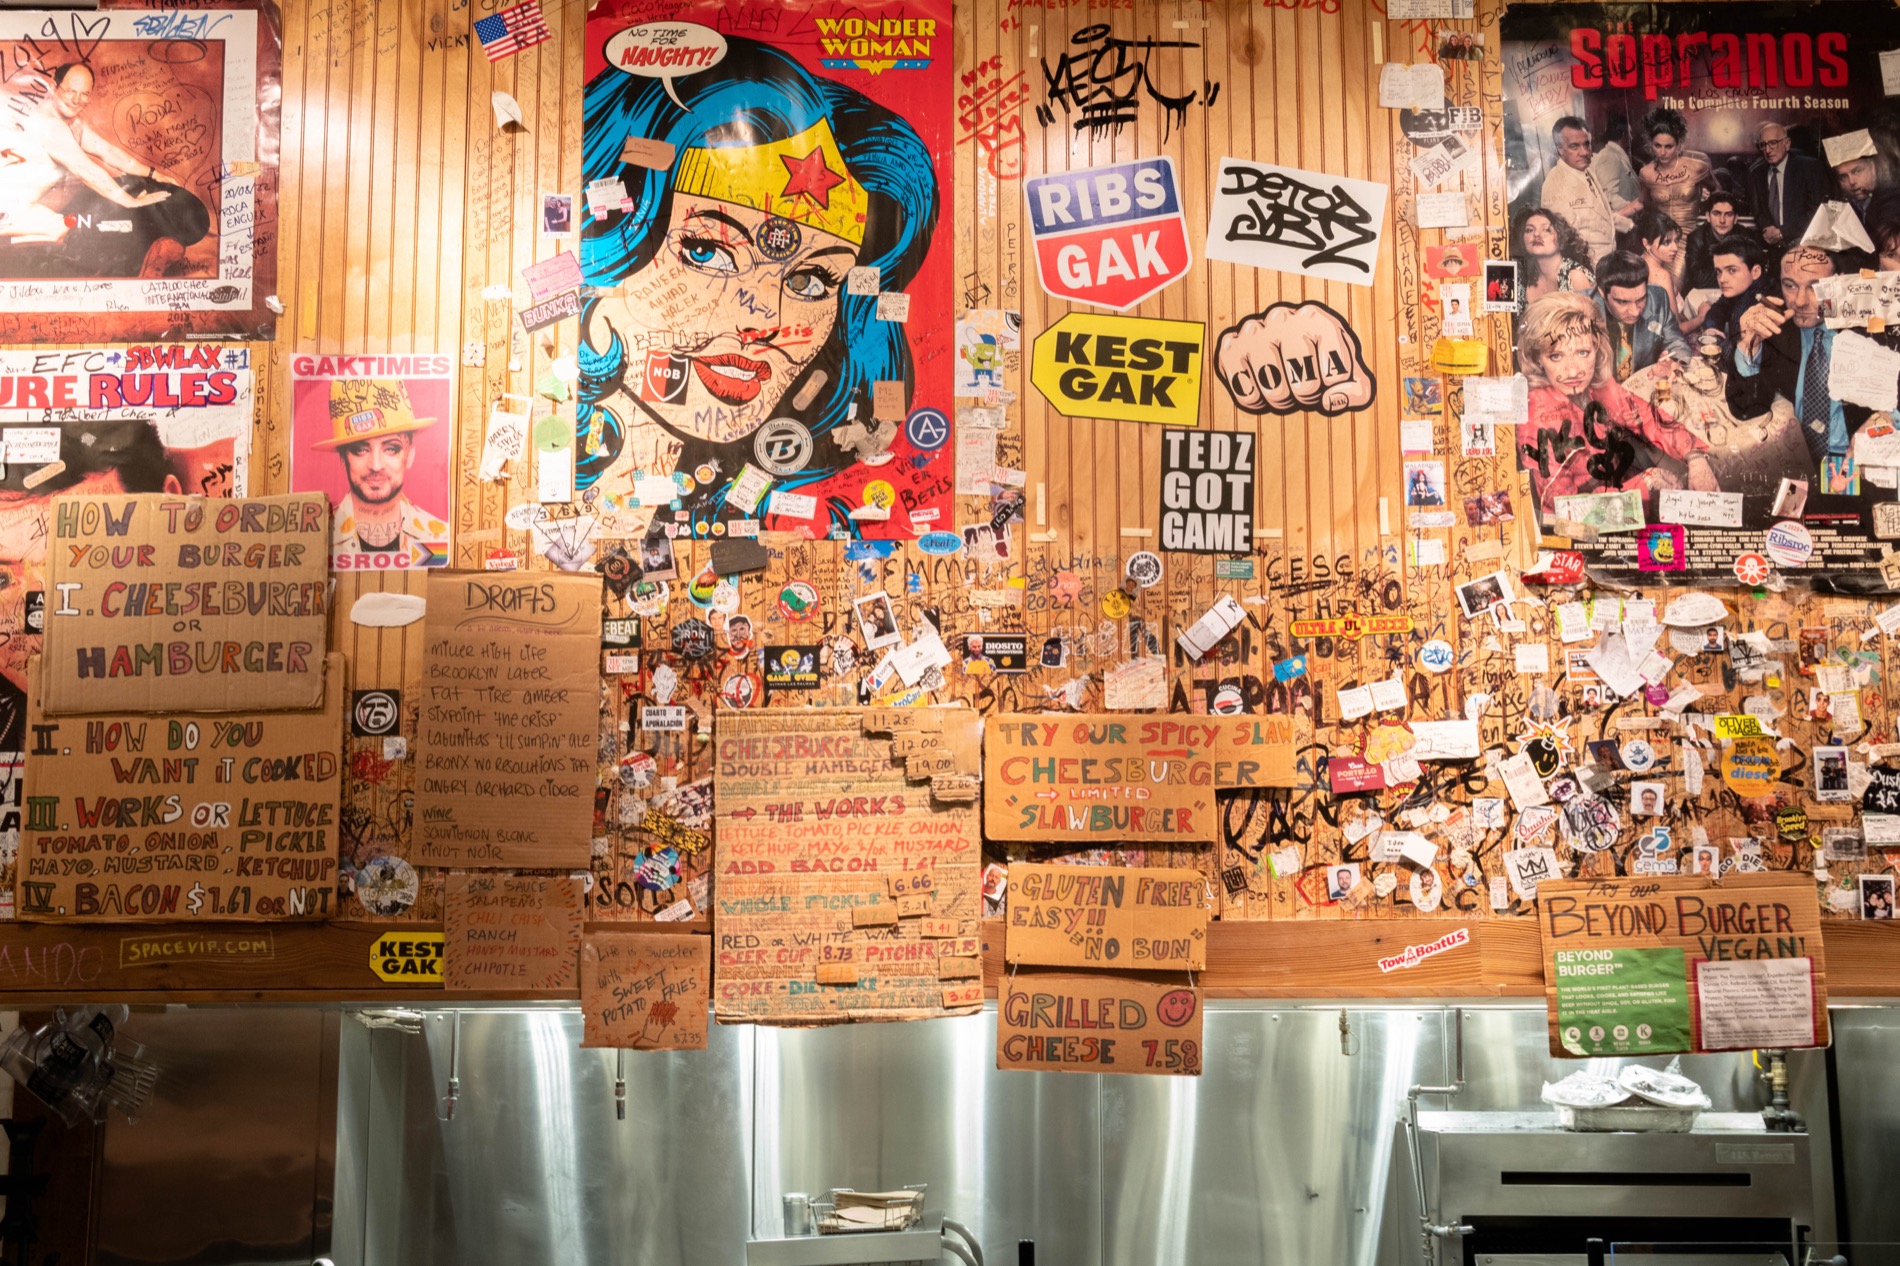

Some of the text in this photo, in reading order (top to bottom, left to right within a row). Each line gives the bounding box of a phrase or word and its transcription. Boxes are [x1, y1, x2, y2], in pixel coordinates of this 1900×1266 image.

[628, 28, 688, 37] NO TIME
[816, 18, 936, 38] WONDER
[650, 38, 678, 46] FOR
[820, 39, 930, 57] WOMAN
[620, 46, 717, 67] NAUGHTY!
[1569, 27, 1849, 100] Sopranos
[1663, 97, 1849, 112] The Complete Fourth Season
[1037, 168, 1167, 227] RIBS
[1057, 230, 1169, 290] GAK
[125, 345, 223, 371] SBWLAX
[1054, 332, 1199, 374] KEST
[293, 356, 450, 376] GAKTIMES
[653, 365, 681, 380] NOB
[1231, 350, 1348, 397] COMA
[89, 373, 237, 409] RULES
[1059, 367, 1177, 408] GAK
[1166, 431, 1252, 471] TEDZ
[1163, 471, 1251, 511] GOT
[56, 501, 323, 538] HOW TO ORDER
[1162, 511, 1250, 550] GAME
[1768, 532, 1811, 552] Ribsroc
[68, 543, 306, 569] YOUR BURGER
[1554, 553, 1580, 572] STAR
[102, 581, 328, 618] CHEESEBURGER
[172, 619, 202, 632] OR
[1295, 618, 1409, 635] ULTRA LECCE
[985, 642, 1023, 650] DIOSITO
[76, 641, 313, 679] HAMBURGER
[767, 674, 790, 682] GAME
[646, 709, 667, 717] CUARTO
[874, 714, 910, 726] 11.25
[1719, 717, 1756, 727] OLIVER
[719, 711, 847, 735] HAMBURGER
[85, 722, 147, 753] HOW
[168, 721, 200, 751] DO
[211, 721, 263, 748] YOU
[1000, 722, 1295, 748] TRY OUR SPICY SLAW
[721, 735, 882, 760] CHEESEBURGER
[902, 739, 938, 751] 12.00
[111, 751, 337, 784] WANT COOKED
[721, 762, 793, 776] DOUBLE
[916, 760, 951, 773] 19.00
[1000, 756, 1260, 785] CHEESBURGER
[1337, 767, 1377, 777] PORTELLO
[1069, 786, 1152, 800] LIMITED
[75, 795, 184, 829] WORKS
[191, 803, 231, 829] OR
[238, 798, 333, 829] LETTUCE
[765, 796, 905, 823] THE WORKS
[1777, 814, 1807, 824] Brooklyn
[785, 823, 844, 840] TOMATO,
[847, 820, 963, 837] PICKLE, ONION
[1518, 813, 1554, 840] Omaha
[1780, 821, 1806, 832] Speed
[37, 830, 326, 856] TOMATO, ONION, PICKLE
[894, 837, 970, 854] MUSTARD
[29, 855, 335, 881] MAYO, MUSTARD, KETCHUP
[724, 857, 878, 875] ADD BACON
[504, 881, 547, 892] SAUCE
[895, 874, 931, 892] 6.66
[1022, 874, 1207, 910] GLUTEN FREE?
[75, 883, 181, 915] BACON
[186, 882, 251, 915] $1.61
[256, 896, 285, 916] OR
[289, 887, 333, 916] NOT
[466, 895, 543, 908] JALAPEÑOS
[720, 893, 881, 914] WHOLE PICKLE
[902, 900, 927, 913] 3.21
[467, 912, 546, 925] CHILI CRISP
[1012, 906, 1107, 936] EASY!!
[1548, 896, 1794, 938] BEYOND BURGER
[467, 930, 517, 942] RANCH
[926, 921, 950, 935] 9.41
[129, 940, 268, 960] SPACEVIP.COM
[380, 941, 444, 958] KEST
[721, 931, 853, 950] RED OR WHITE
[1698, 936, 1805, 961] VEGAN!
[507, 946, 559, 957] MUSTARD
[720, 947, 812, 966] BEER CUP
[824, 945, 853, 960] 8.73
[866, 942, 935, 962] PITCHER
[1557, 950, 1613, 962] BEYOND
[382, 958, 439, 975] GAK
[465, 963, 528, 976] CHIPOTLE
[598, 972, 622, 989] with
[612, 969, 667, 1003] SWEET
[721, 981, 774, 999] COKE
[602, 977, 697, 1026] POTATO FRIES
[948, 988, 980, 1002] 3.67
[1004, 990, 1148, 1030] GRILLED
[1003, 1034, 1199, 1068] CHEESE 7.58
